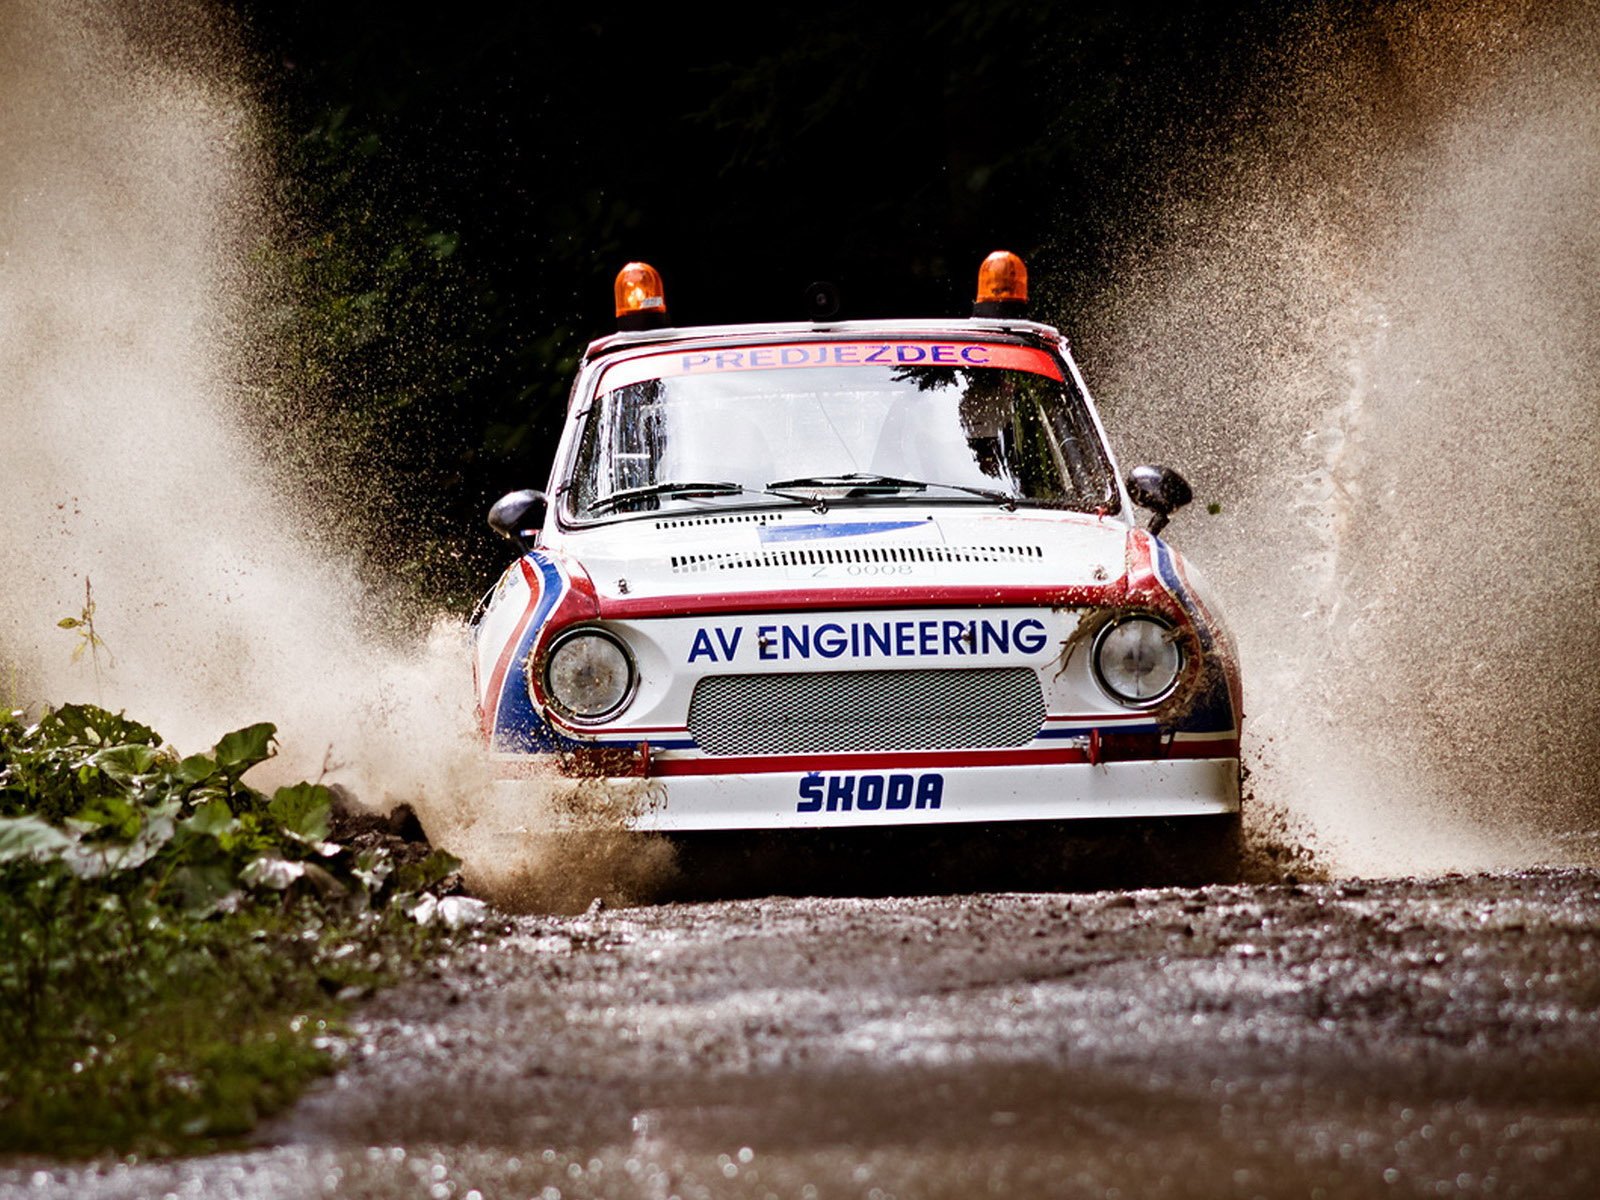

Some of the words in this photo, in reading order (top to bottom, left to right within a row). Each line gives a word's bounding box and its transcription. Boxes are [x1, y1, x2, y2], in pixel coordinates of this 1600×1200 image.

[682, 345, 989, 372] PREDJEZDEC
[687, 626, 743, 663] AV
[758, 618, 1048, 661] ENGINEERING
[796, 771, 944, 813] ŠKODA
